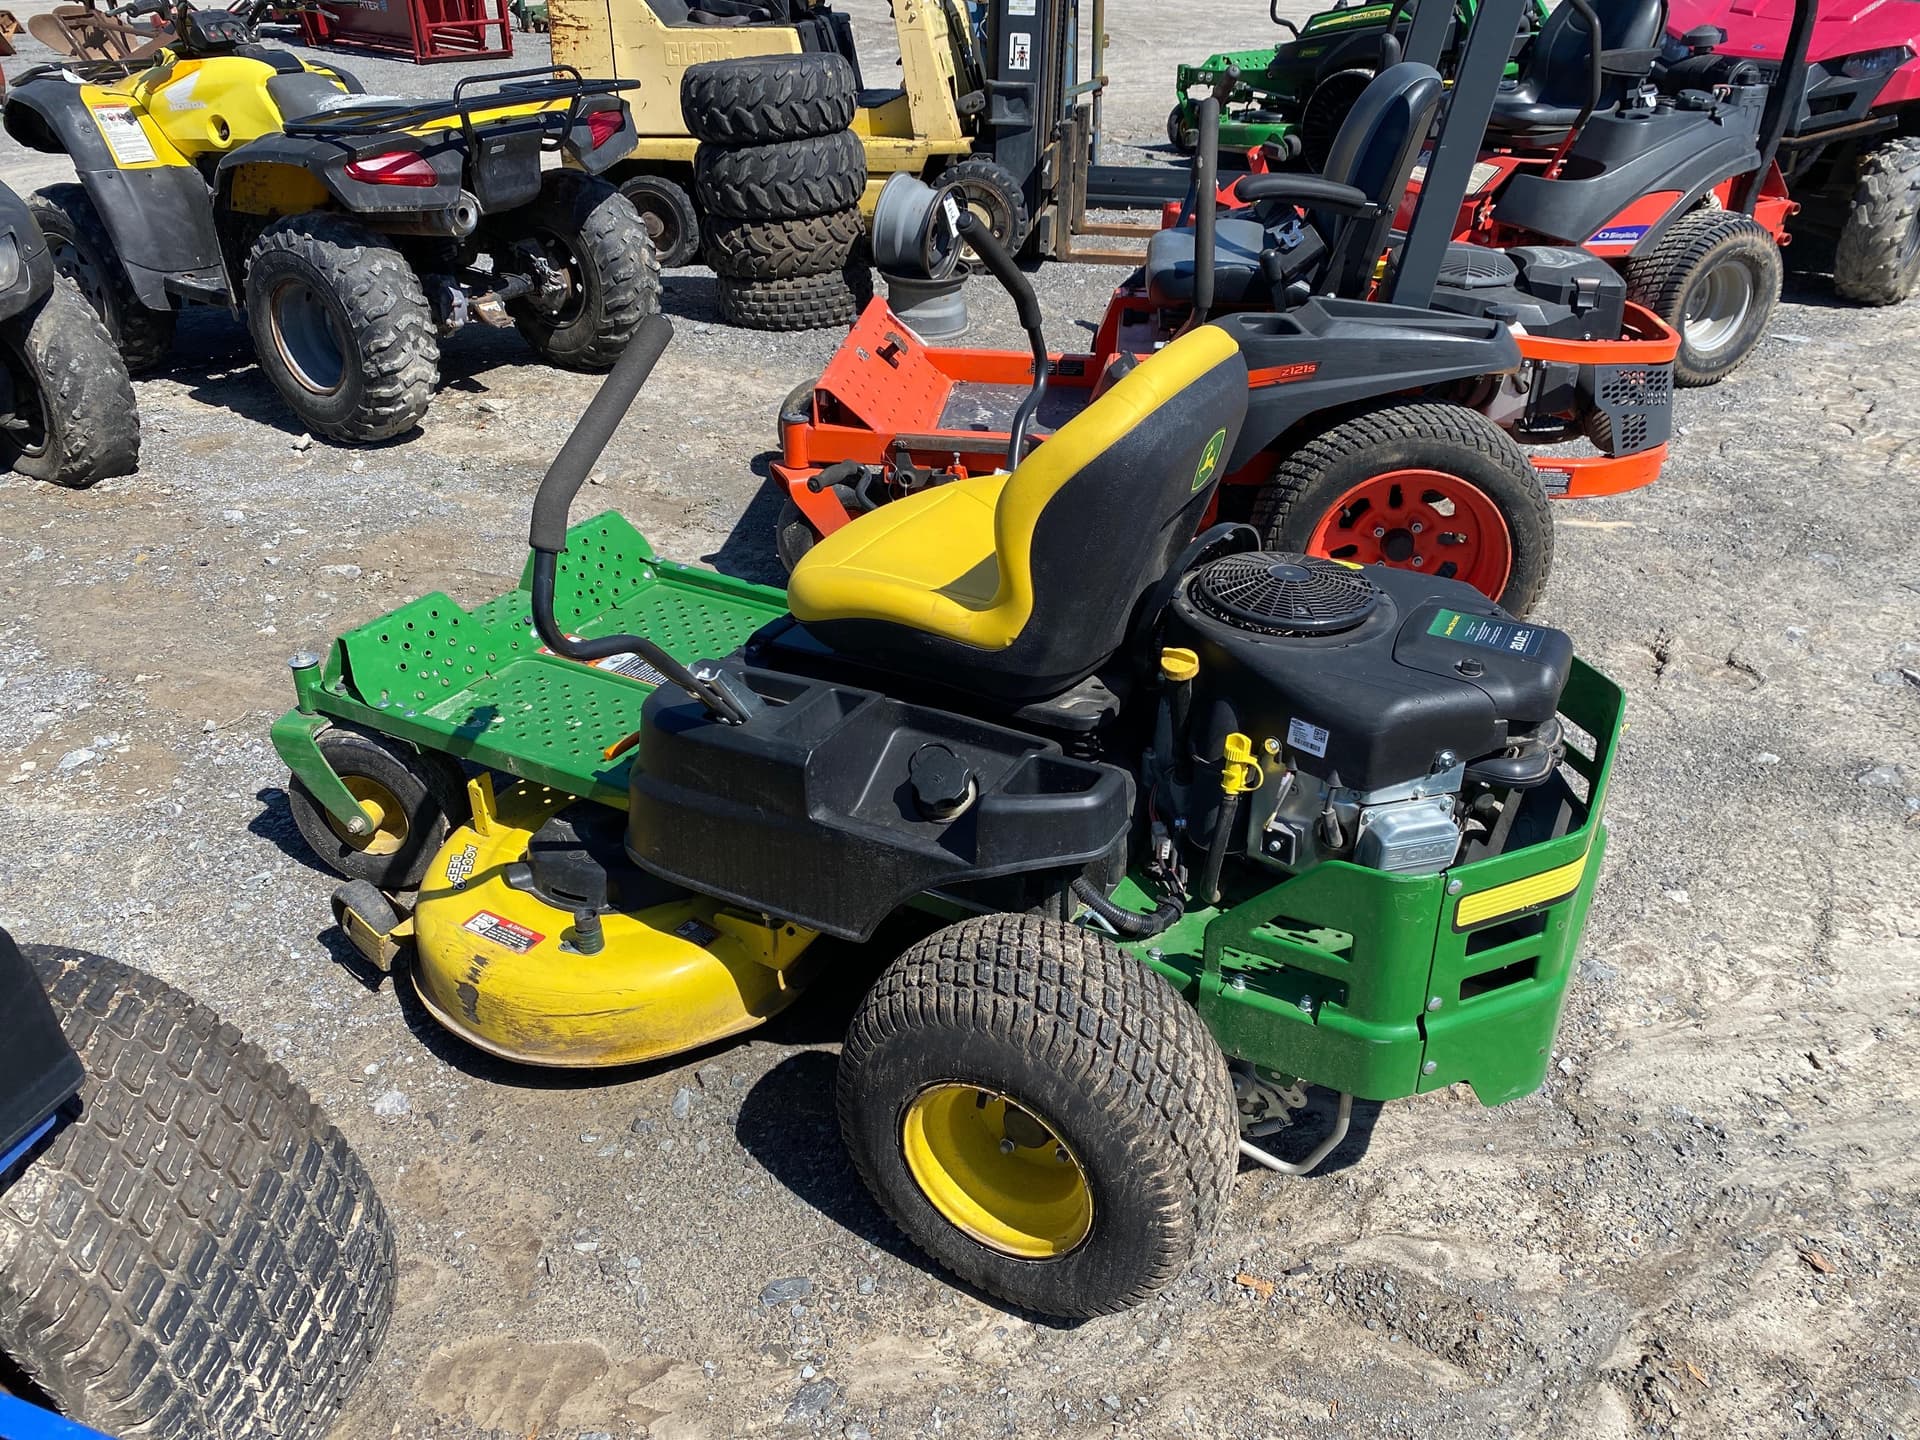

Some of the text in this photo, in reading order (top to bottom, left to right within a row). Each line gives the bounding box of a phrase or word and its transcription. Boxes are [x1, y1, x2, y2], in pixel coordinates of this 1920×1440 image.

[169, 101, 208, 112] HONDA
[447, 854, 463, 882] DEEP
[459, 844, 477, 877] ACCEL
